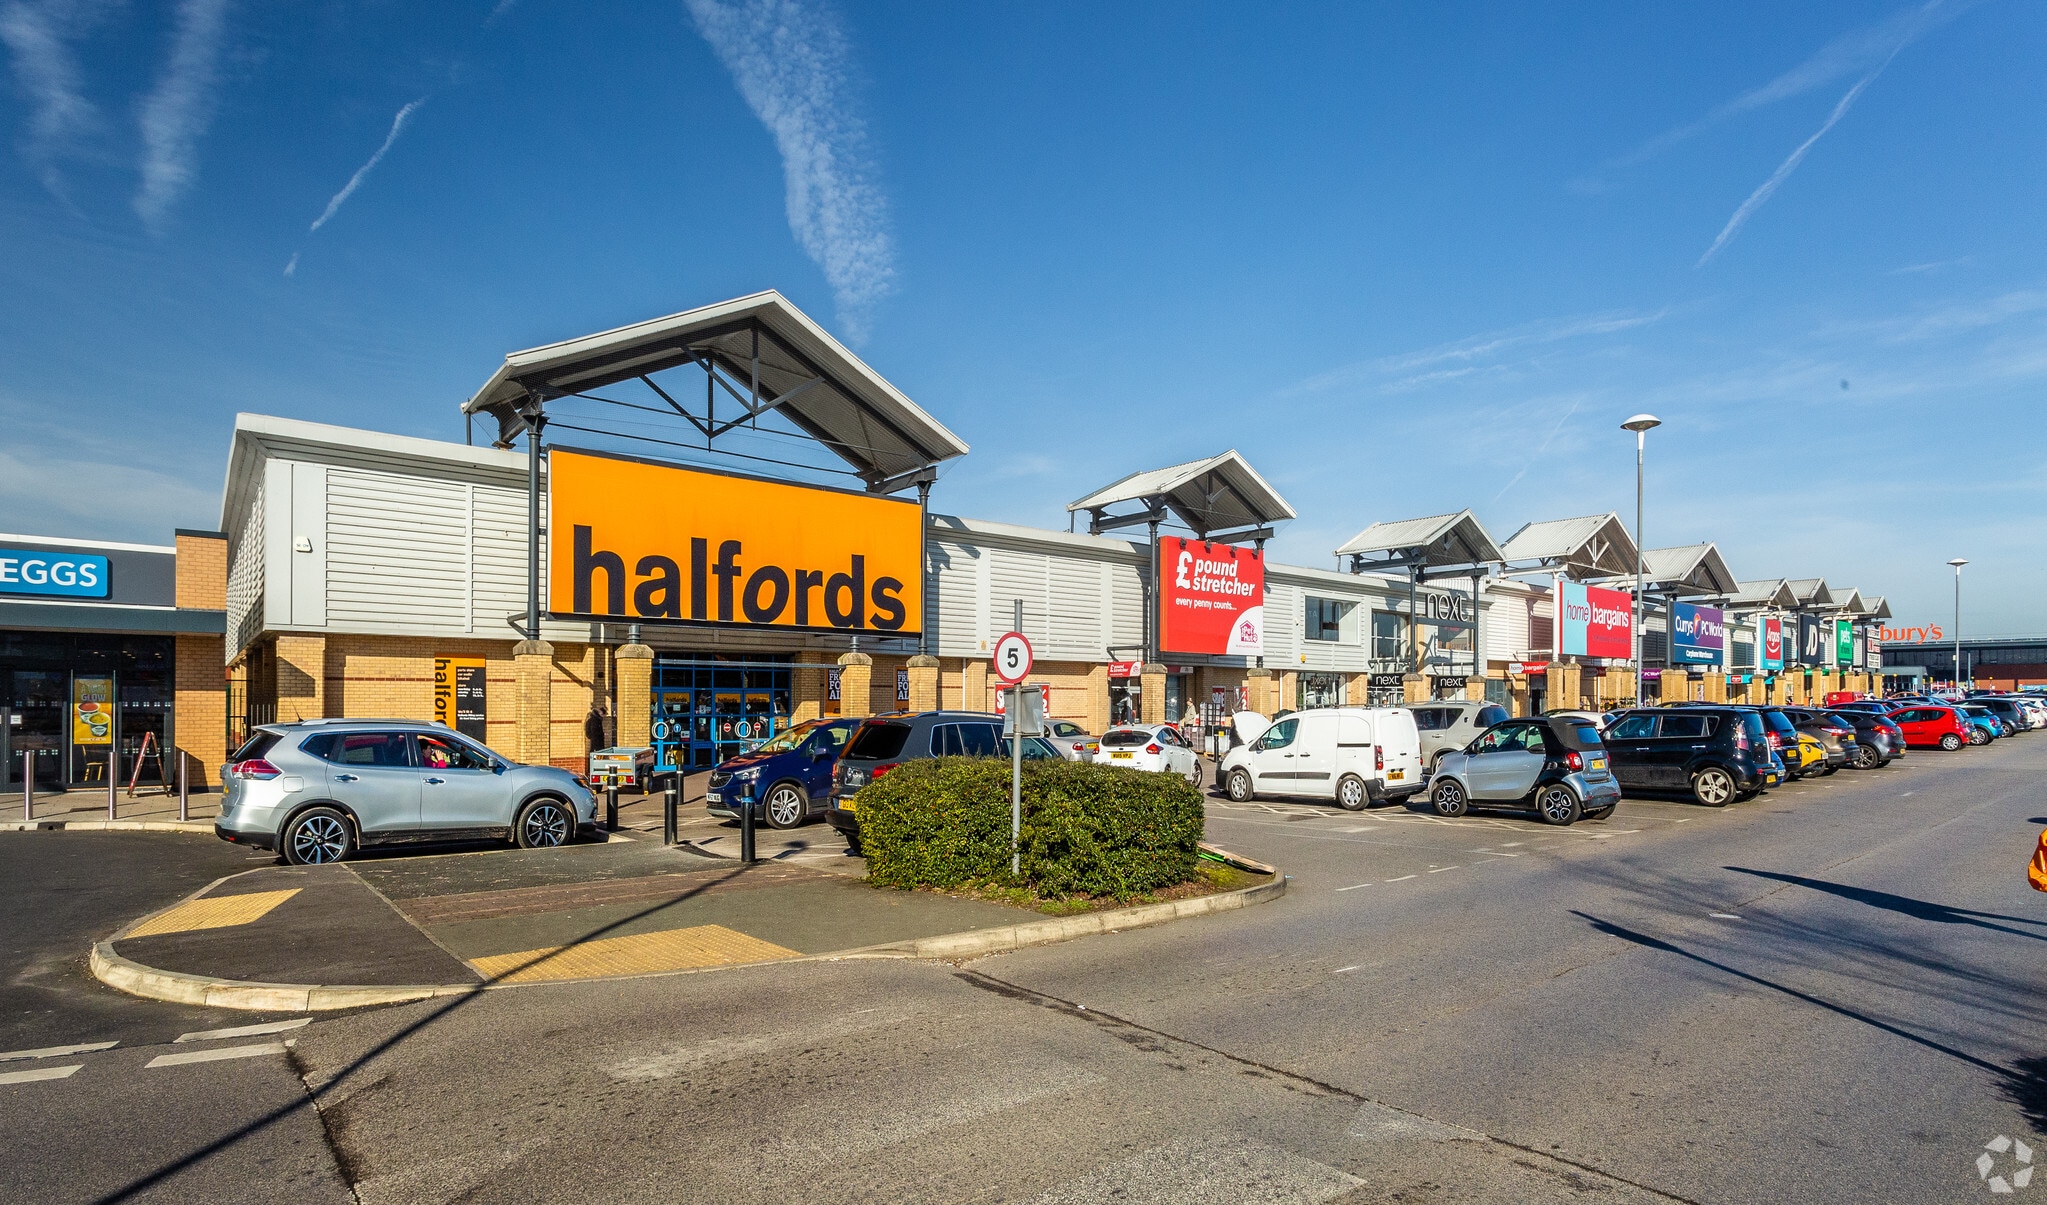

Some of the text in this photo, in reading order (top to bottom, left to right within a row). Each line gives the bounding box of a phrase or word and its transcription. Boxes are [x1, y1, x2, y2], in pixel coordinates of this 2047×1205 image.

[0, 557, 98, 588] EGGS
[573, 523, 906, 631] halfords
[1194, 558, 1239, 578] pound
[1192, 574, 1256, 597] stretcher
[1175, 596, 1193, 609] every
[1193, 599, 1212, 611] penny
[1426, 592, 1467, 622] next
[1566, 599, 1629, 631] home bargains
[1675, 615, 1694, 637] Currys
[1709, 621, 1723, 638] World
[1766, 626, 1780, 647] Argos
[1805, 624, 1818, 656] JD
[1007, 647, 1019, 669] 5
[829, 681, 840, 690] FO
[897, 674, 909, 682] FR
[897, 681, 909, 691] FO
[1375, 675, 1399, 685] next
[1440, 676, 1463, 686] next
[434, 658, 451, 725] halfor
[829, 690, 840, 700] AL
[897, 691, 909, 700] AL
